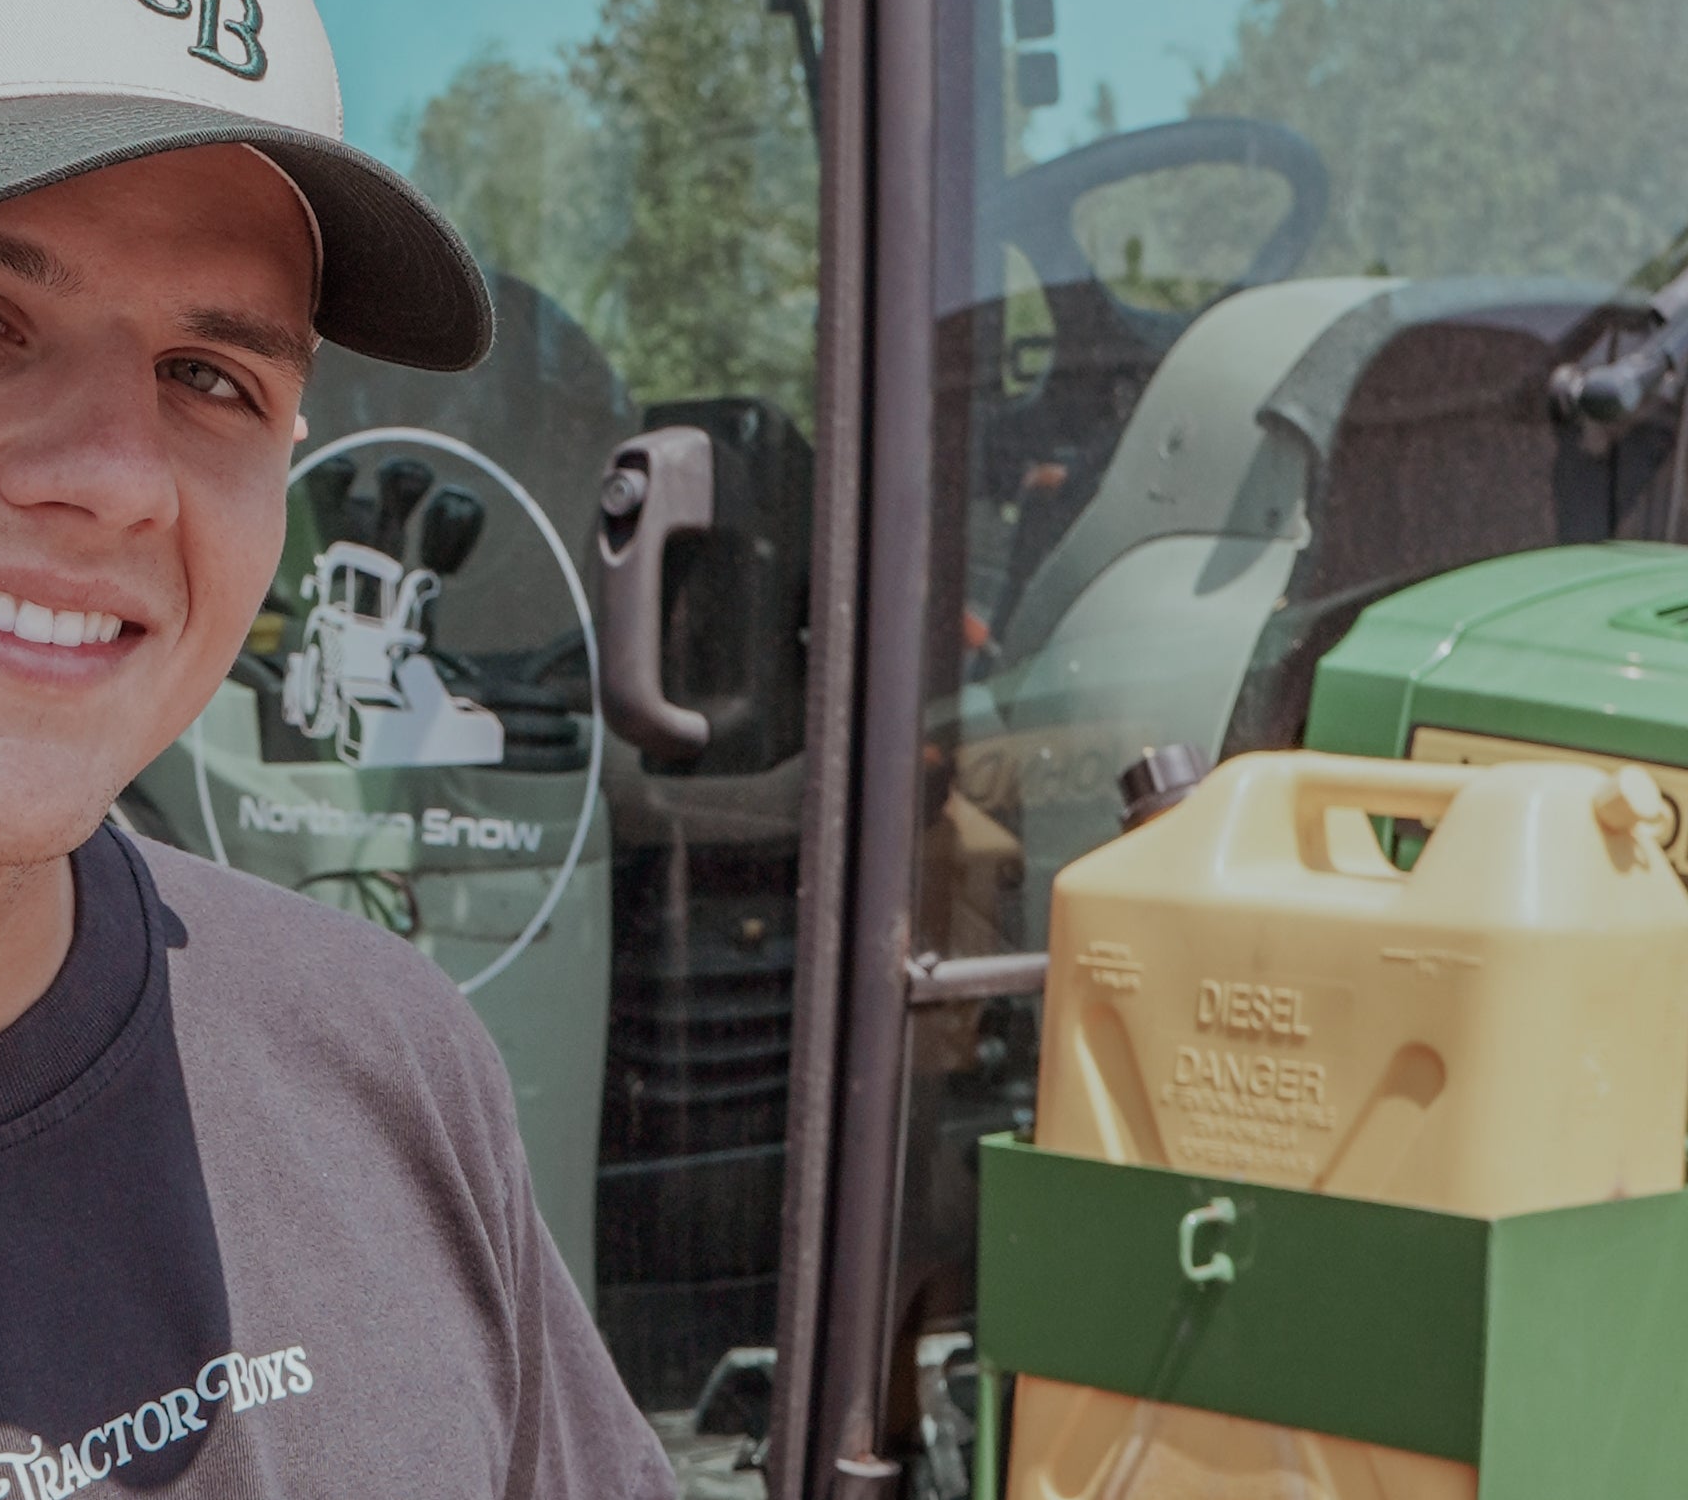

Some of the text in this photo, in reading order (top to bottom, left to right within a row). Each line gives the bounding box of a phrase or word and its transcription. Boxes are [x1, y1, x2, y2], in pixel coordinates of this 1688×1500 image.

[422, 807, 543, 853] Snow
[1197, 978, 1311, 1040] DIESEL
[1173, 1045, 1326, 1104] DANGER
